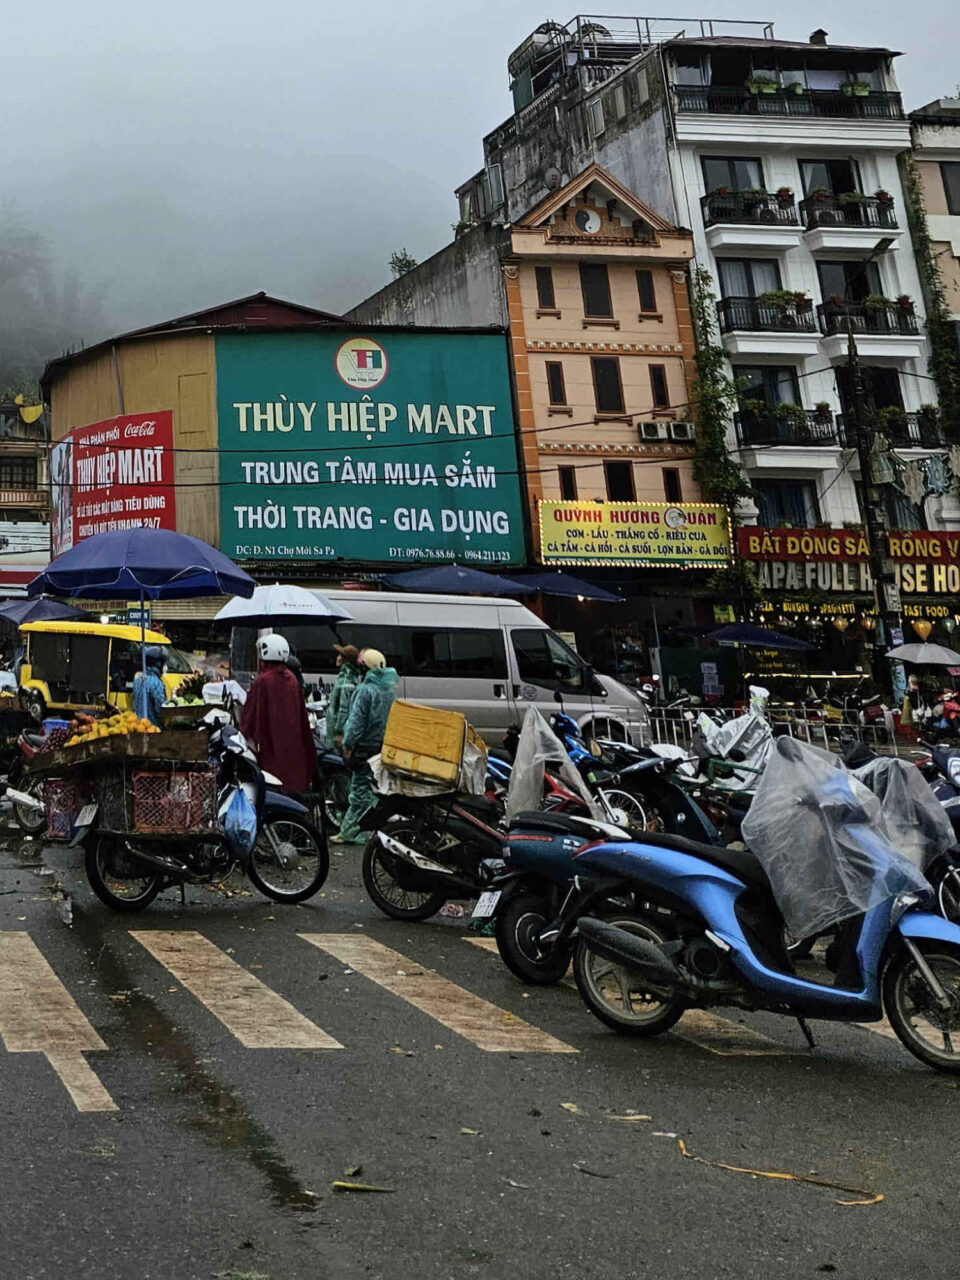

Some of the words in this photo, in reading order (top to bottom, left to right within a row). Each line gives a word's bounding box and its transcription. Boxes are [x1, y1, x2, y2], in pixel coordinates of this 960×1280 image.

[233, 394, 317, 433] THÙY
[327, 394, 398, 441] HIỆP
[407, 402, 496, 437] MART
[91, 432, 105, 446] PHÂN
[106, 426, 120, 442] PHỐI
[77, 450, 95, 493] THÙY
[97, 446, 116, 496] HIỆP
[118, 446, 164, 485] MART
[241, 461, 320, 485] TRUNG
[326, 455, 377, 485] TÂM
[384, 462, 439, 487] MUA
[444, 450, 497, 488] SẮM
[124, 496, 142, 511] TIÊU
[143, 494, 166, 509] DÙNG
[234, 499, 286, 529] THỜI
[292, 506, 373, 530] TRANG
[393, 507, 436, 532] GIA
[442, 509, 509, 541] DỤNG
[553, 507, 603, 523] QUỲNH
[610, 508, 661, 524] HƯƠNG
[566, 528, 585, 538] CƠM
[648, 527, 659, 540] CỐ
[688, 531, 707, 541] CUA
[236, 545, 252, 555] ĐC:
[265, 545, 276, 555] N1
[277, 545, 294, 557] Chợ
[313, 546, 324, 555] Sa
[325, 546, 335, 555] Pa
[389, 547, 405, 557] ĐT:
[547, 541, 559, 552] CÁ
[584, 541, 596, 553] CÁ
[618, 542, 630, 553] CÁ
[632, 541, 652, 554] SUỐI
[657, 544, 674, 557] LỢN
[699, 543, 711, 555] GÀ
[749, 529, 782, 554] BẤT
[787, 531, 840, 560] ĐỘNG
[844, 530, 871, 556] SẢ
[890, 531, 941, 558] RỒNG
[759, 560, 800, 591] APA
[805, 561, 855, 592] FULL
[860, 561, 928, 593] HSE
[904, 604, 923, 617] FAST
[926, 605, 950, 618] FOOD
